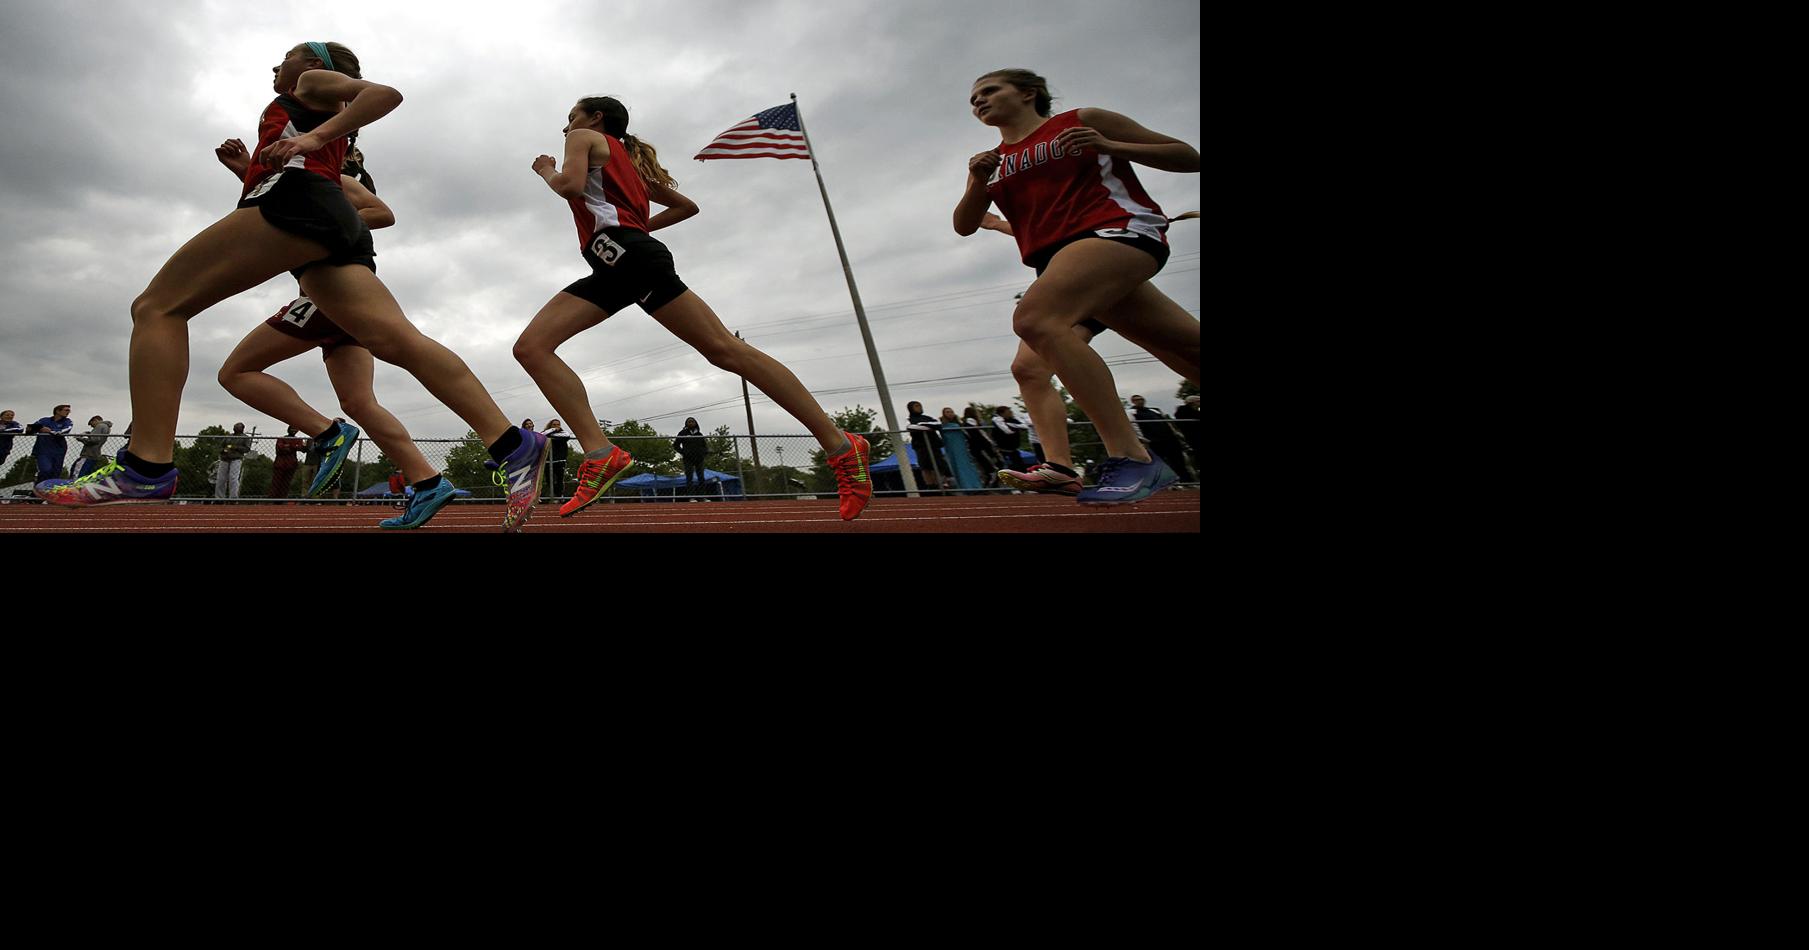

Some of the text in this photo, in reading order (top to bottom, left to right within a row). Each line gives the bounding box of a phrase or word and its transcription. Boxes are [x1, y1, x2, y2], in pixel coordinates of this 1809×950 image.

[594, 238, 618, 263] 3
[289, 301, 313, 323] 4
[508, 465, 532, 494] N
